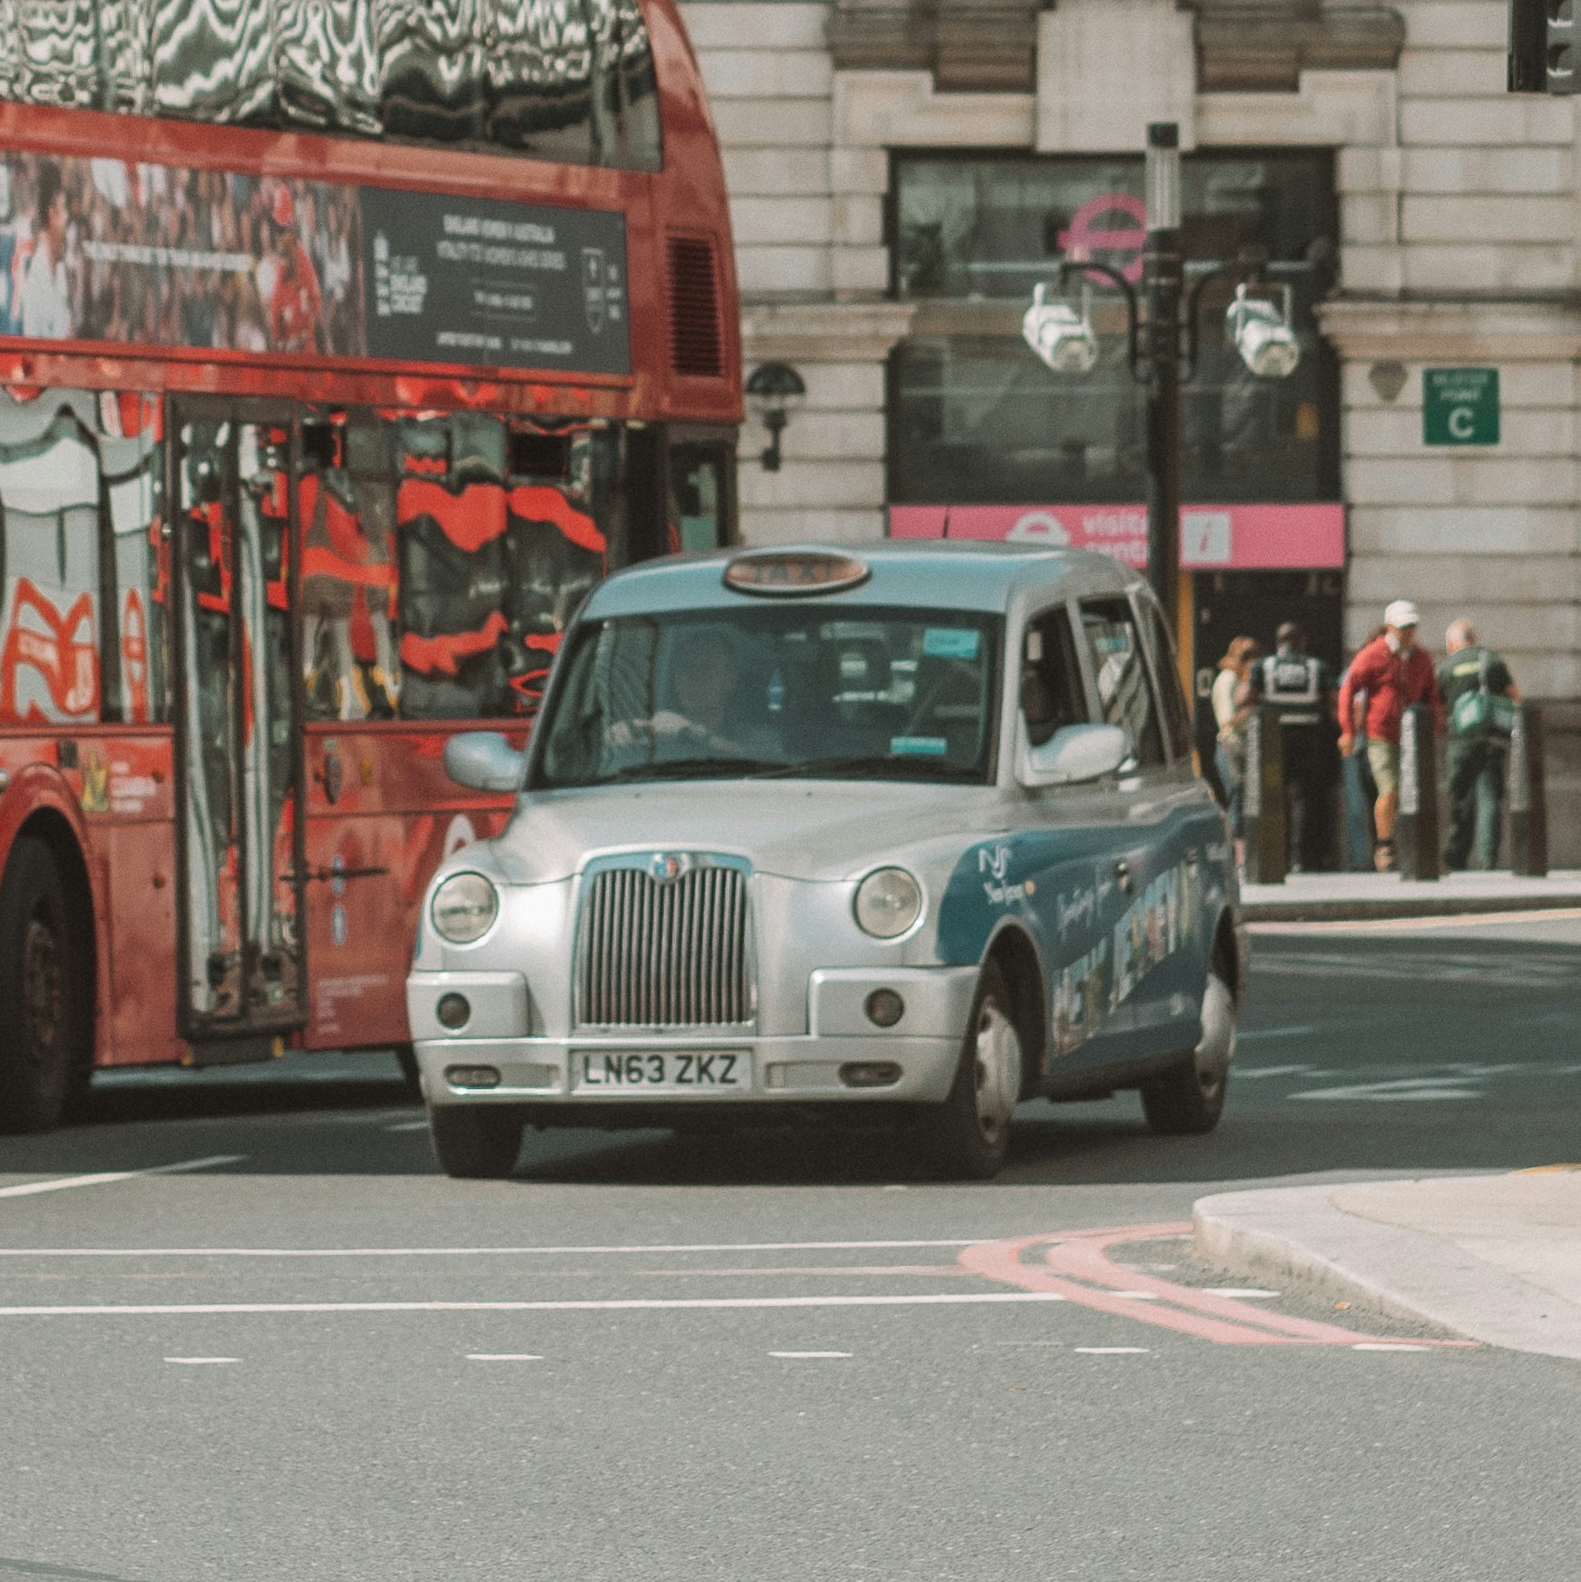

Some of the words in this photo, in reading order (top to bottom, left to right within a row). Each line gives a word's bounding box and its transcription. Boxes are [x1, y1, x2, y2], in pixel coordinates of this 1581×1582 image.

[1448, 406, 1474, 439] C
[583, 1054, 665, 1085] LN63
[675, 1053, 738, 1084] ZKZ
